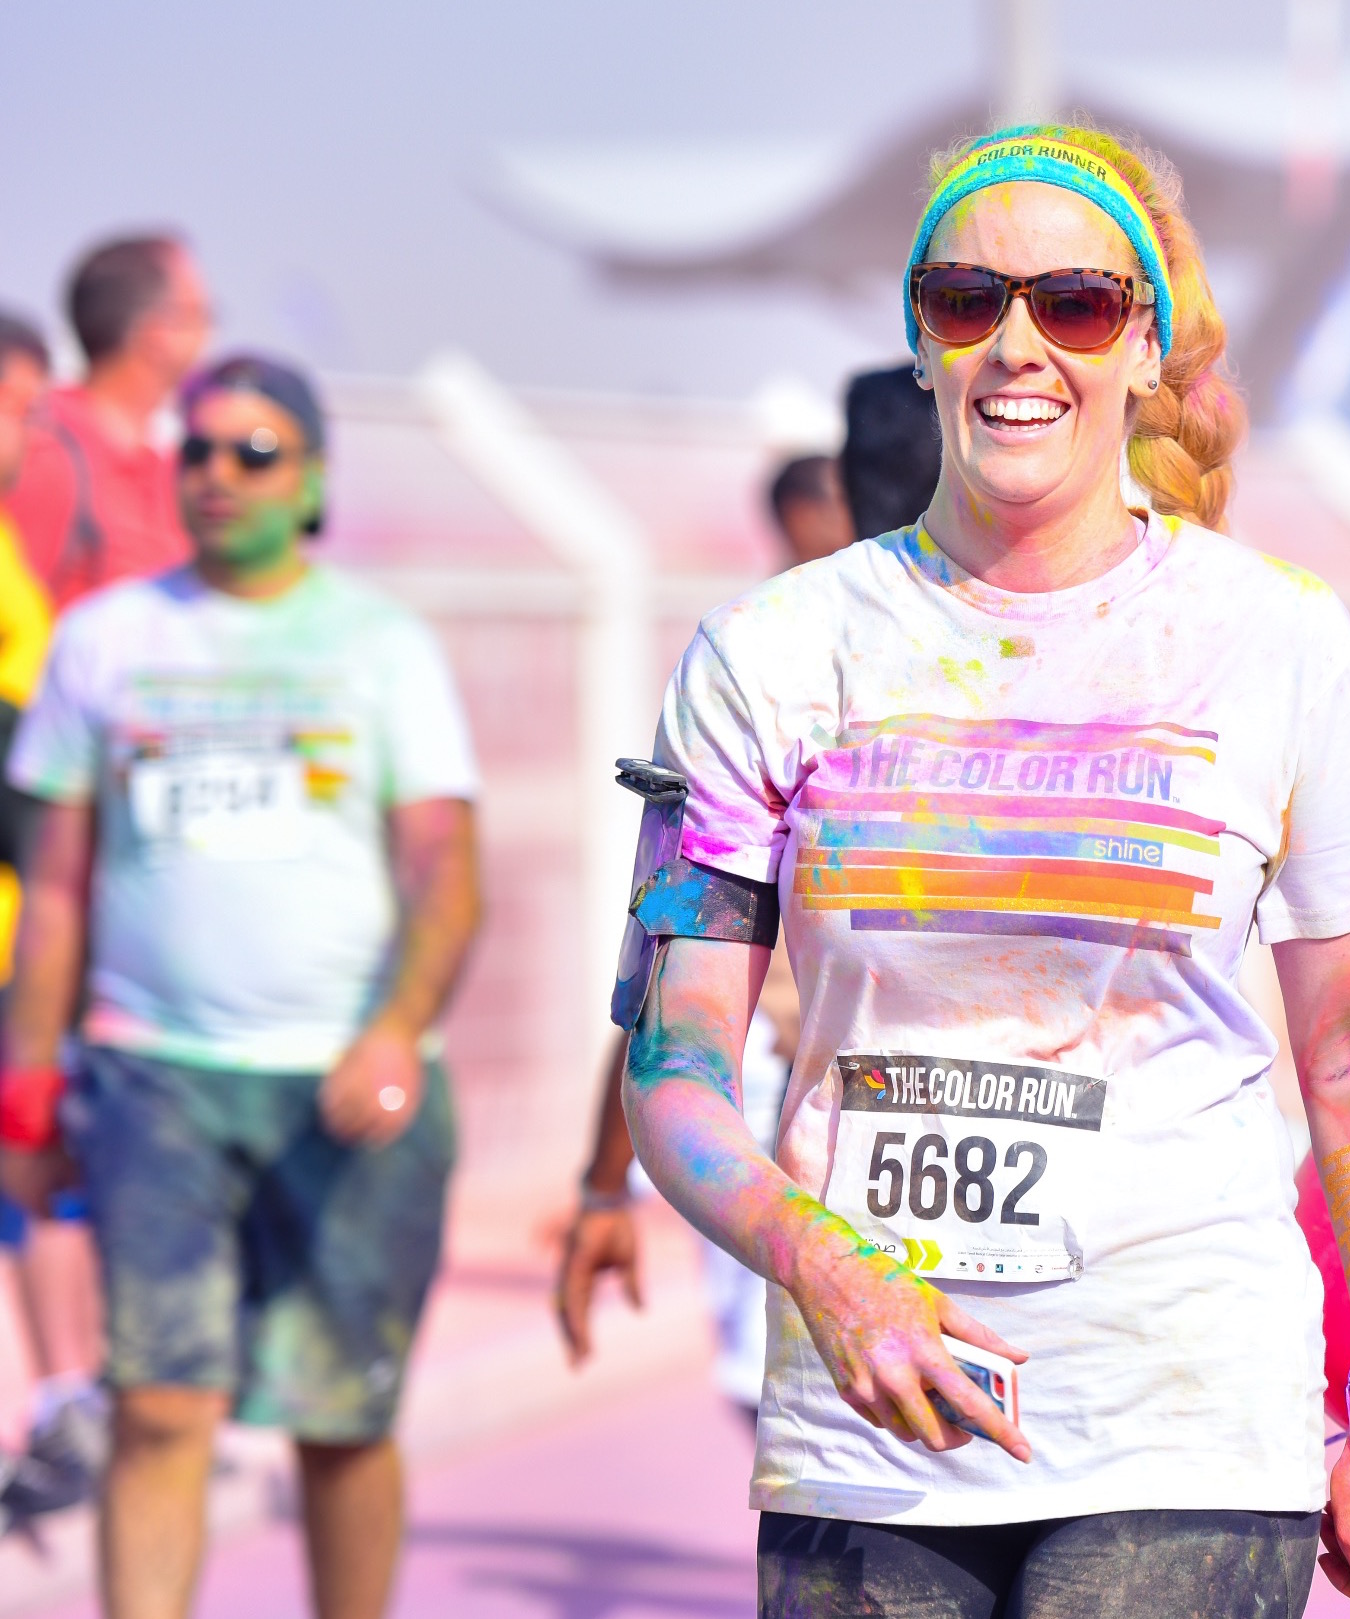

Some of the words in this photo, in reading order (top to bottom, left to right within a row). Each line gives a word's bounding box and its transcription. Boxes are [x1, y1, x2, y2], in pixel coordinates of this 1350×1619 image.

[976, 145, 1033, 167] COLOR
[1037, 145, 1107, 181] RUNNER
[848, 737, 928, 788] THE
[929, 749, 1076, 793] COLOR
[1093, 838, 1161, 863] shine
[886, 1067, 927, 1106] THE
[929, 1068, 1015, 1111] COLOR
[866, 1131, 1048, 1227] 5682
